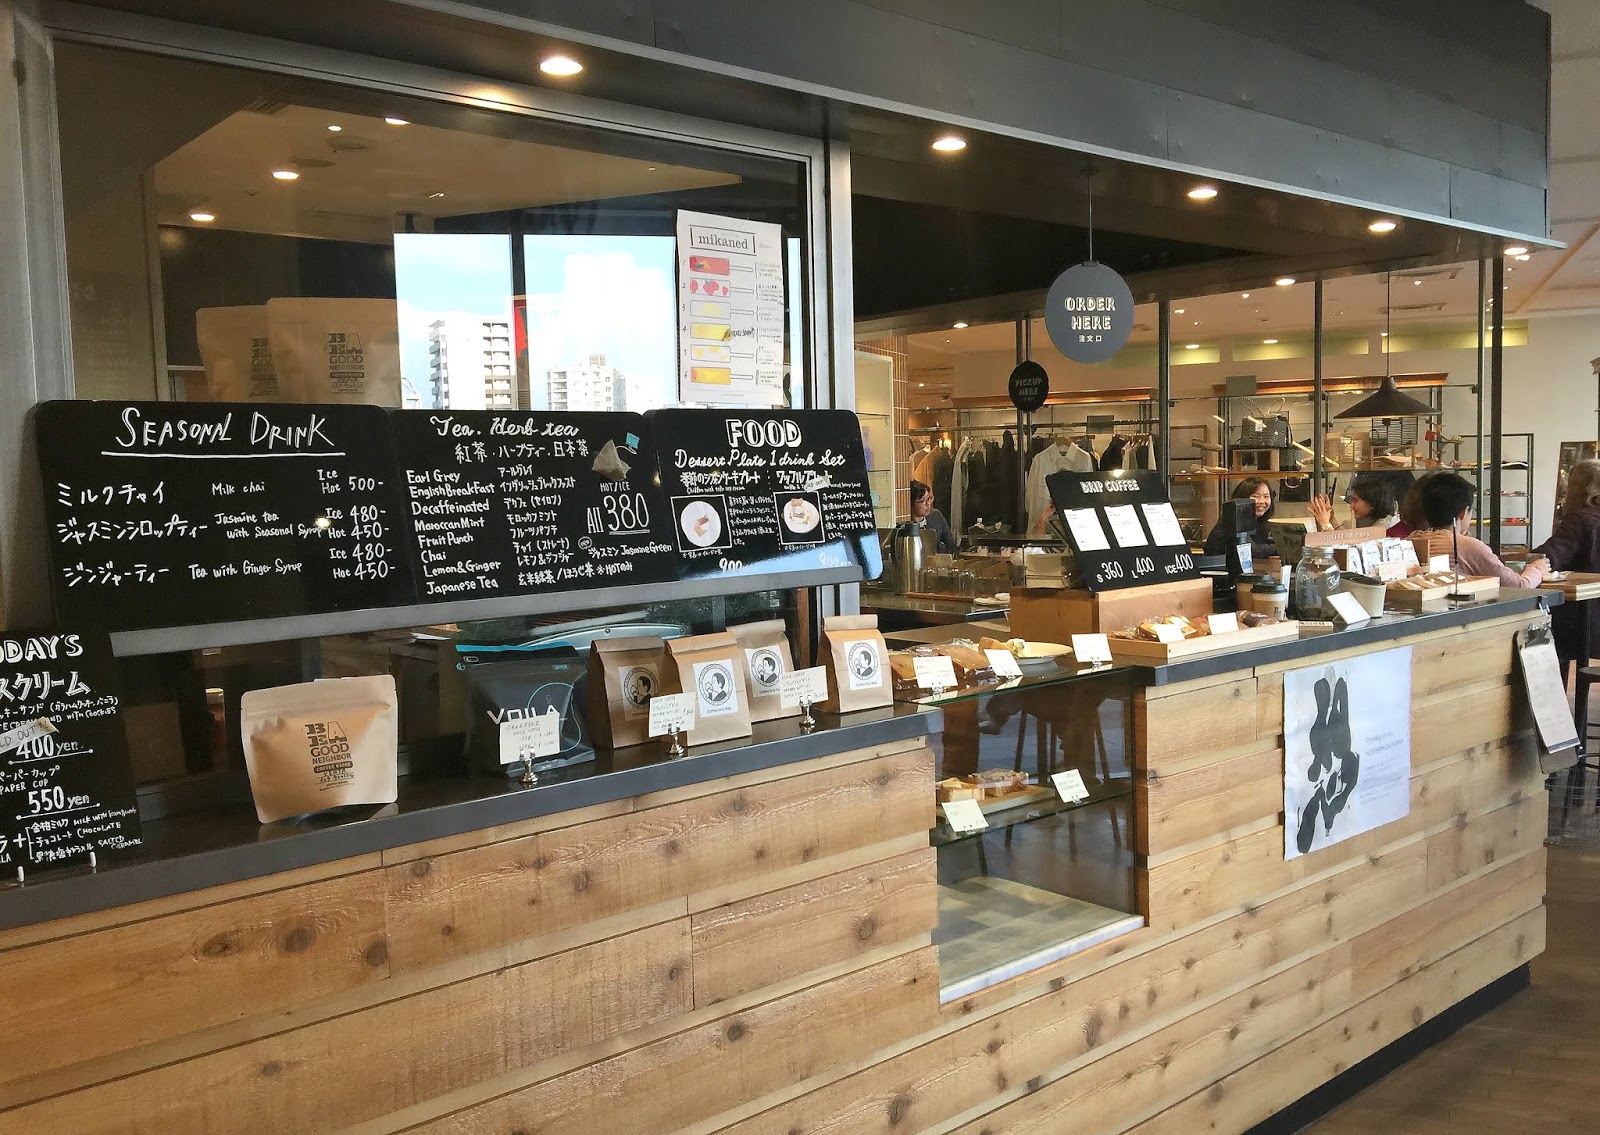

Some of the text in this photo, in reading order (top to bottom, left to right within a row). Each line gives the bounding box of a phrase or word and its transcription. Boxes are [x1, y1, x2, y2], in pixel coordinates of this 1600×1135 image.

[698, 233, 749, 250] mikaned
[1064, 296, 1116, 312] ORDER
[1071, 316, 1111, 330] HERE
[1079, 335, 1102, 343] 注文口
[329, 355, 363, 364] GOOD
[1015, 378, 1042, 387] PICKUP
[1019, 387, 1038, 396] HERE
[116, 407, 335, 450] SEASONAL DRINK
[540, 422, 580, 437] tea
[725, 419, 802, 448] FOOD
[675, 449, 726, 468] Dessert
[727, 450, 766, 467] Plate
[779, 450, 815, 466] drink
[819, 449, 846, 467] Set
[317, 469, 338, 481] Ice
[406, 469, 461, 484] Earl Grey
[497, 464, 533, 477] アールグレイ
[58, 481, 165, 507] ミルクチャイ
[212, 482, 266, 496] Milk chai
[321, 482, 341, 494] Hot
[1080, 479, 1140, 494] DRIP COFFEE
[325, 508, 344, 520] Ice
[411, 499, 490, 516] Decaffeinated
[603, 493, 650, 531] 380
[215, 511, 280, 525] Jasmine tea
[56, 514, 208, 545] ジャスミンシロップティー
[226, 527, 250, 539] with
[255, 524, 294, 538] Seasonal
[328, 527, 347, 540] Hot
[509, 525, 559, 539] フルーツパンチ
[418, 532, 474, 549] Fruit Punch
[329, 548, 348, 560] Ice
[421, 551, 447, 564] Chai
[188, 559, 303, 580] Tea with Ginger Syrup
[1097, 560, 1124, 583] S 360
[1131, 556, 1155, 579] L 400
[1165, 553, 1194, 575] ICE 400
[63, 562, 170, 587] ジンジャーティー
[333, 567, 352, 580] Hot
[426, 576, 500, 596] Japanese Tea
[0, 634, 84, 664] DAY'S
[17, 725, 36, 741] OUT
[327, 721, 347, 744] A
[16, 734, 54, 759] 400
[310, 743, 349, 757] GOOD
[312, 753, 351, 765] NEIGHBOR
[316, 763, 335, 772] COFFEE
[0, 778, 49, 795] PAPER CUP
[28, 785, 90, 814] 550 yen
[73, 815, 91, 826] MILK
[35, 822, 122, 848] チョコレート CHOCOLATE
